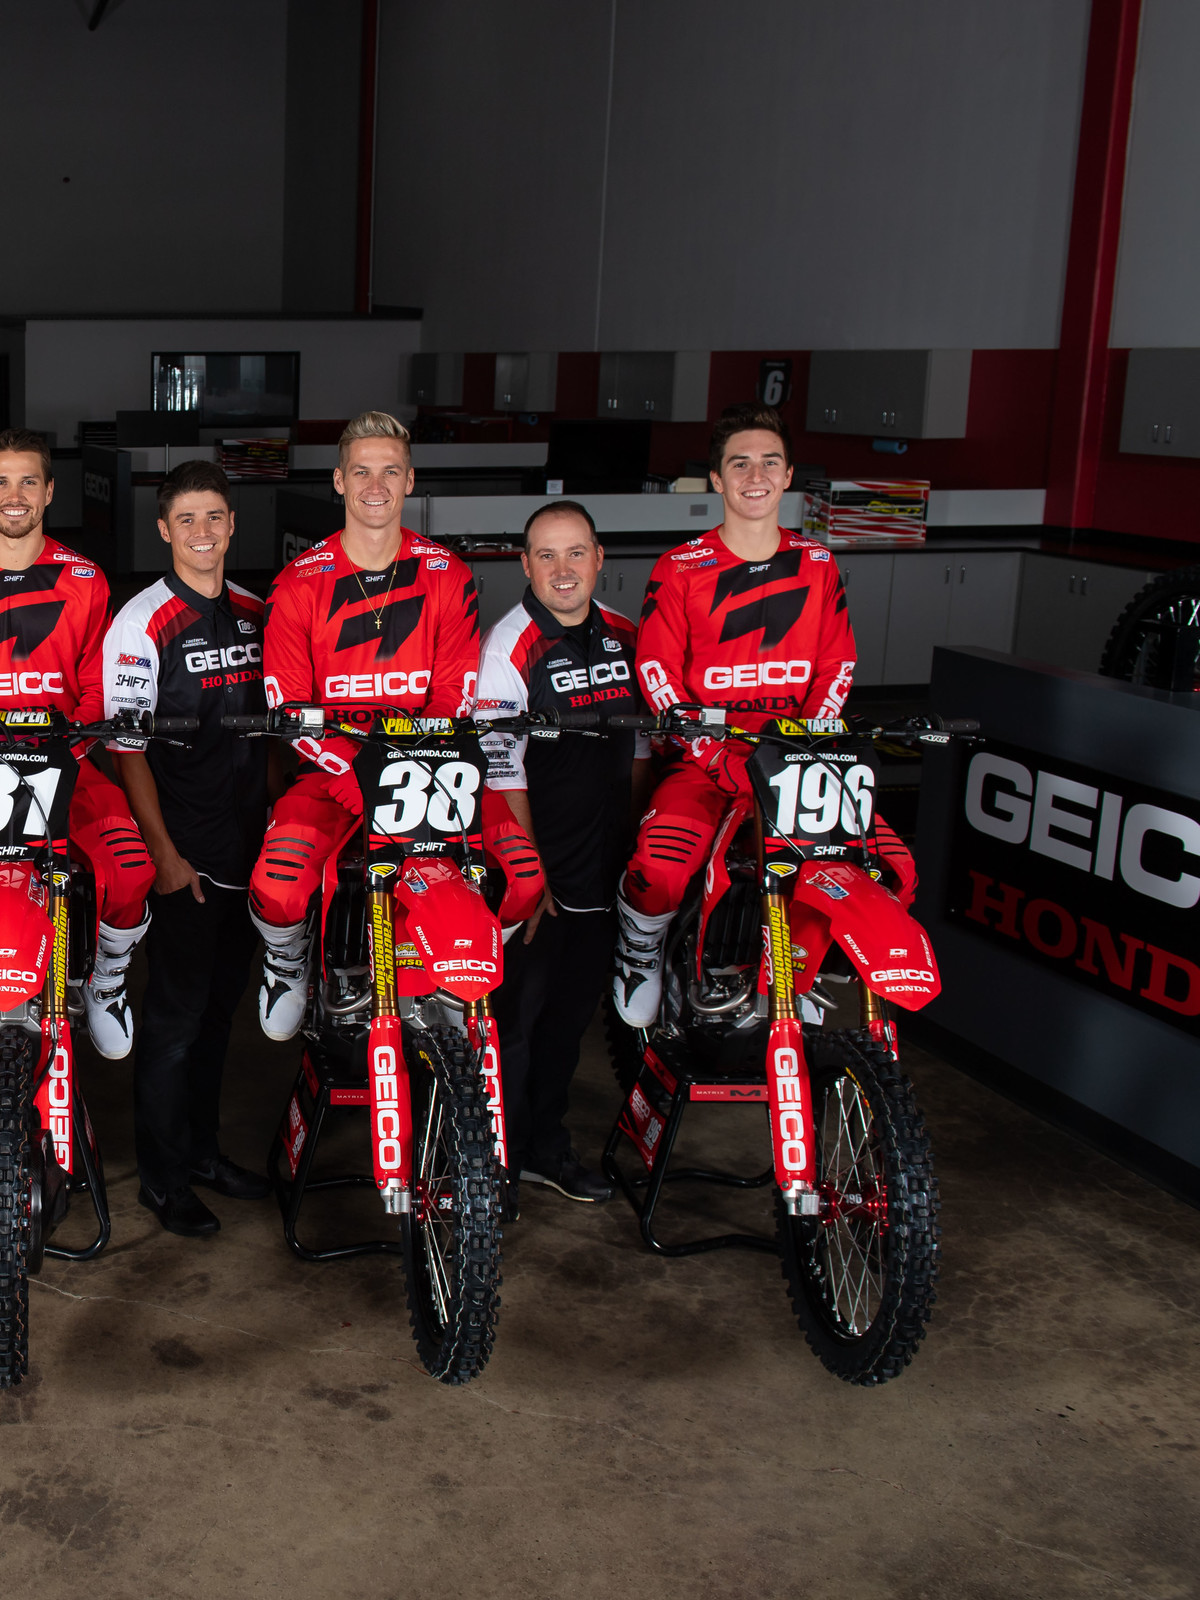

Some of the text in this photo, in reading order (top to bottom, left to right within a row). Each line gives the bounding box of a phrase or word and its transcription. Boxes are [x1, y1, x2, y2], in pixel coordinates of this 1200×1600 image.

[763, 370, 785, 406] 6
[53, 553, 95, 566] GEICO
[294, 552, 334, 567] GEICO
[411, 546, 450, 557] GEICO
[670, 548, 714, 561] GEICO
[74, 567, 93, 576] 100%
[428, 560, 448, 569] 100%
[749, 564, 771, 573] SHIFT
[365, 575, 386, 583] SHIFT
[185, 643, 263, 673] GEICO
[115, 674, 149, 690] SHIFT
[201, 669, 263, 689] HONDA
[325, 670, 432, 698] GEICO
[551, 660, 630, 693] GEICO
[703, 660, 811, 690] GEICO
[474, 699, 519, 710] AMSOIL
[568, 686, 632, 708] HONDA
[116, 737, 145, 747] ARC
[531, 730, 560, 738] ARC
[919, 734, 950, 743] ARC
[372, 761, 480, 835] 38
[769, 762, 875, 837] 196
[412, 842, 446, 853] SHIFT
[813, 846, 847, 856] SHIFT
[372, 904, 386, 996] Connection
[415, 926, 433, 956] DUNLOP
[844, 934, 869, 966] DUNLOP
[36, 935, 47, 969] DUNLOP
[56, 906, 67, 998] Connection
[383, 919, 394, 986] Factory
[770, 906, 787, 999] Connection
[781, 921, 794, 990] Factory
[433, 960, 497, 973] GEICO
[871, 969, 935, 982] GEICO
[444, 976, 491, 984] HONDA
[885, 985, 931, 993] HONDA
[48, 1045, 70, 1171] GEICO
[373, 1046, 401, 1170] GEICO
[632, 1089, 651, 1118] GEICO
[774, 1047, 807, 1171] GEICO
